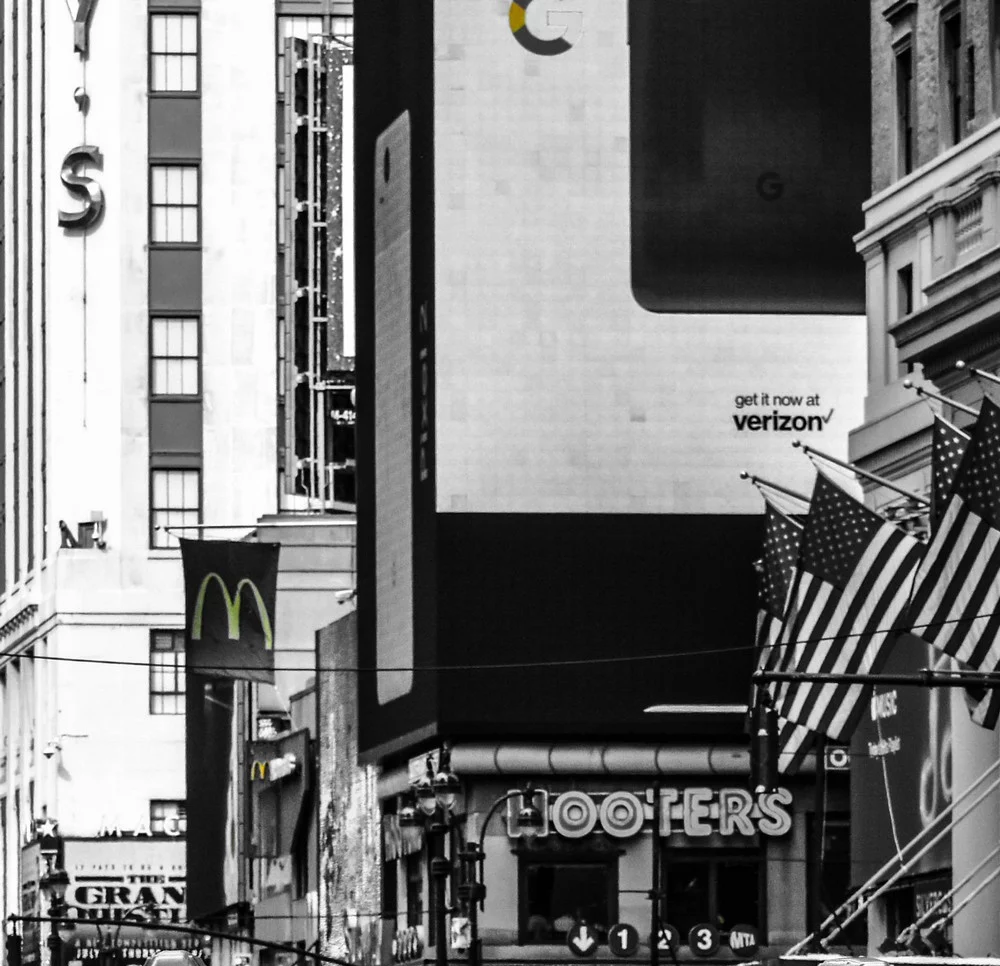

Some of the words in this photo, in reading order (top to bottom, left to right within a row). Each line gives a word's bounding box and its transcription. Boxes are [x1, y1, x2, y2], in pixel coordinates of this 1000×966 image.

[734, 393, 758, 409] get
[761, 393, 770, 406] it
[773, 395, 803, 406] now
[806, 394, 820, 406] at
[732, 410, 823, 431] verizon
[617, 929, 629, 949] 1
[657, 929, 672, 949] 2
[697, 928, 712, 950] 3
[730, 931, 756, 949] MTA
